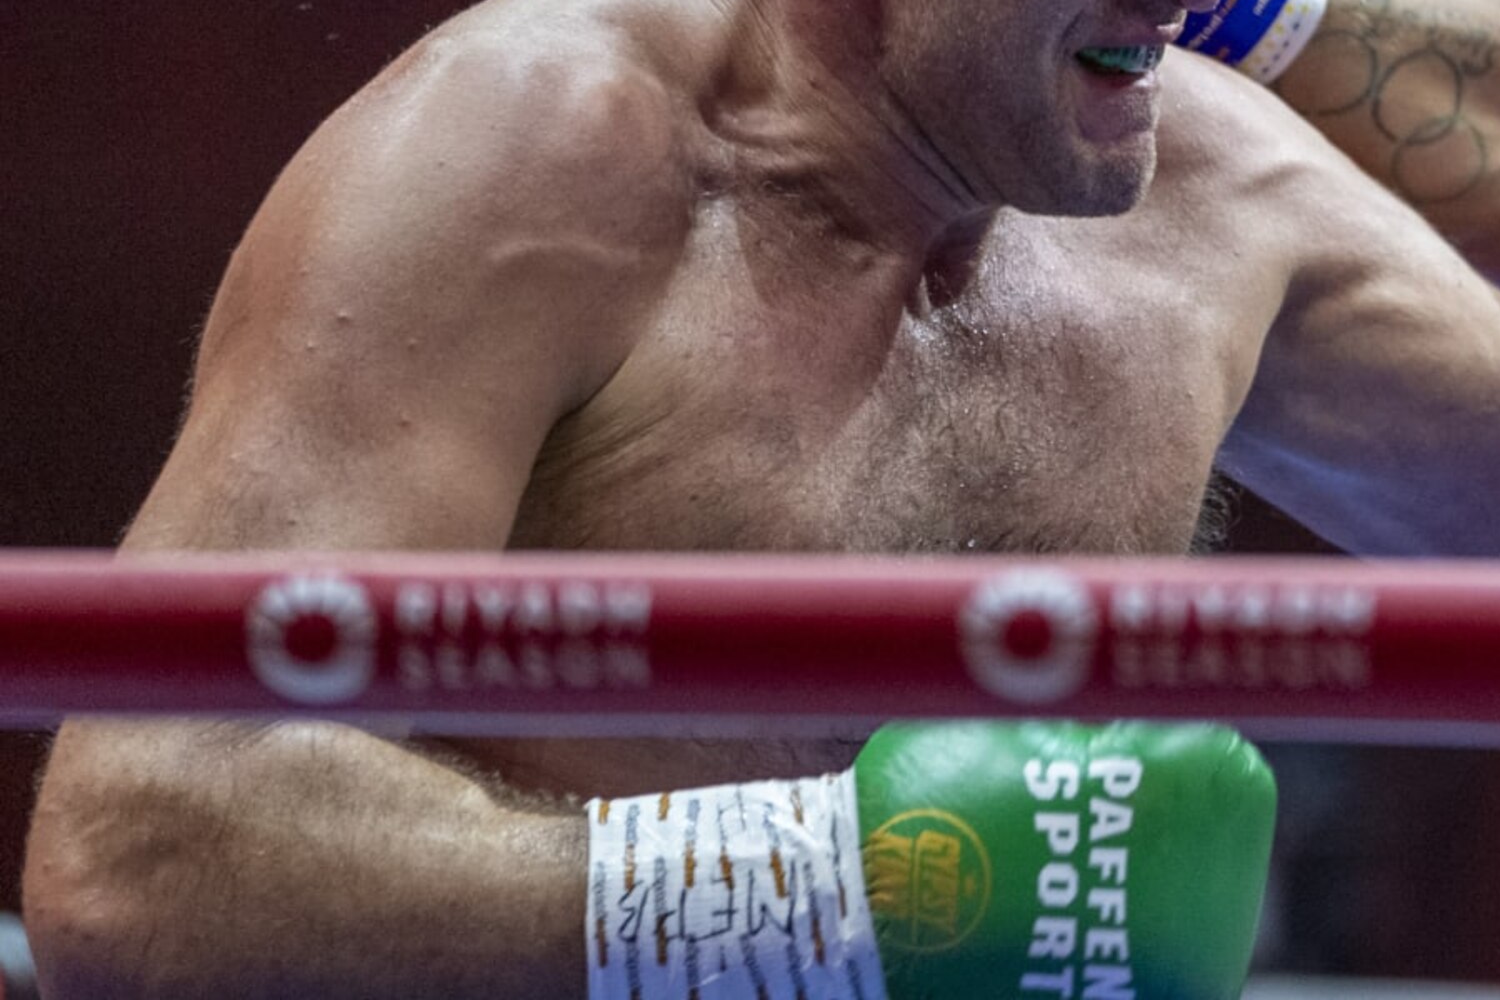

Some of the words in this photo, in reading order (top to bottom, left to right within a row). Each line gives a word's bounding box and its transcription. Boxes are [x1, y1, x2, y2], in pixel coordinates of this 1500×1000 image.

[394, 578, 653, 637] RIYADH
[1110, 579, 1374, 636] RIYADH
[395, 642, 653, 690] SEASON
[1020, 757, 1080, 1000] SPORT
[1082, 756, 1143, 1000] PAFFEN
